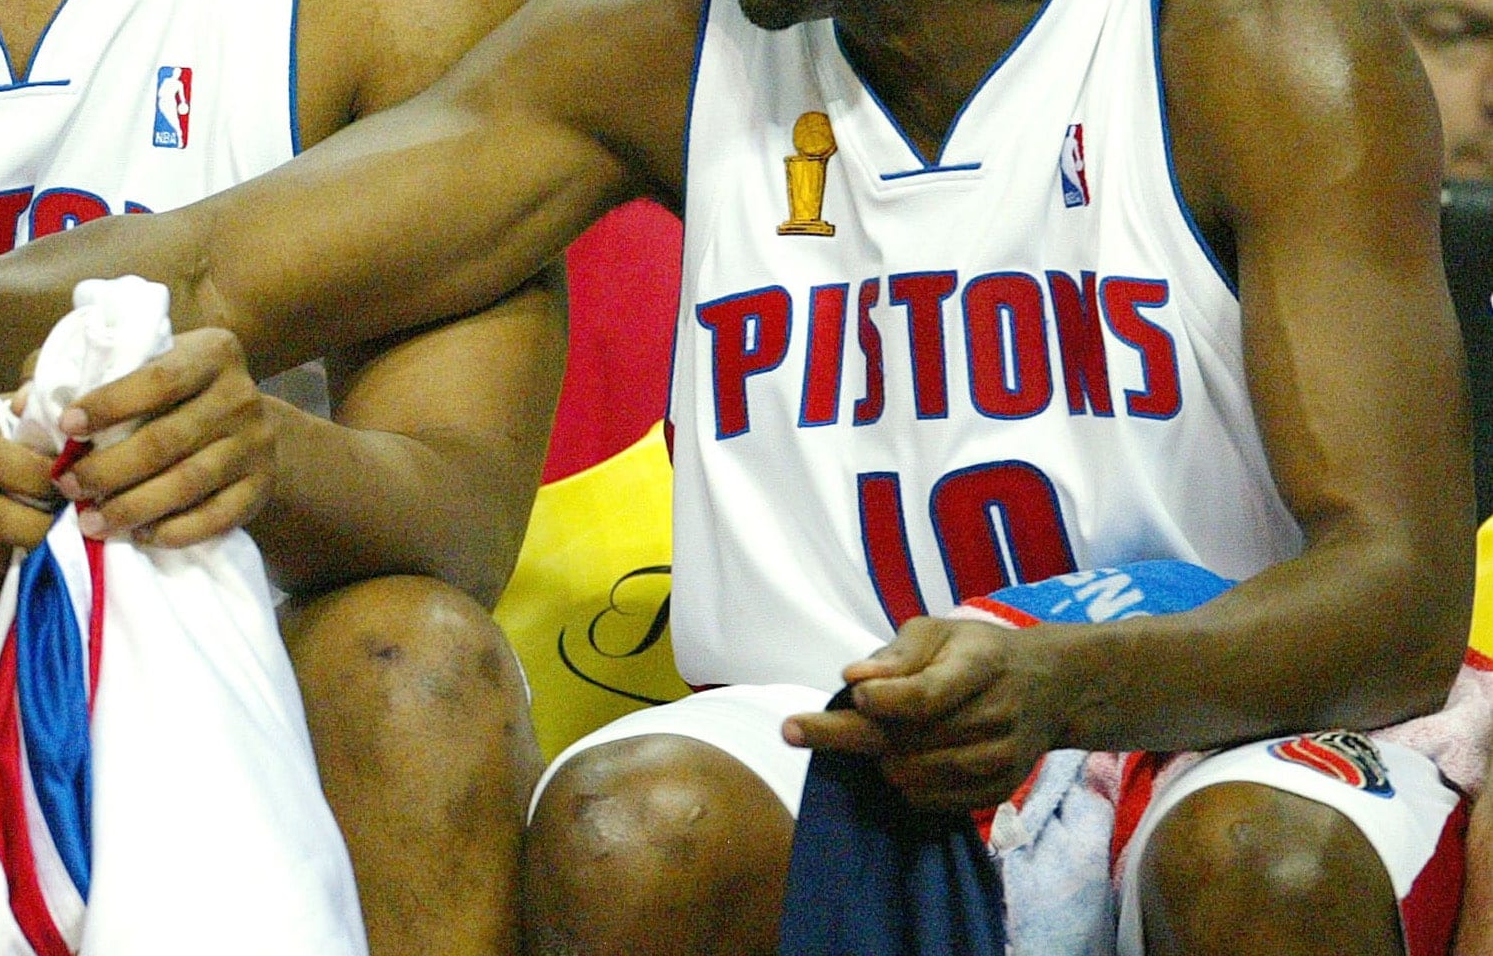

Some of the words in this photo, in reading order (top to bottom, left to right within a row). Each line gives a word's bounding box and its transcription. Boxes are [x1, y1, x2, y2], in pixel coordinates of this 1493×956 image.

[155, 131, 177, 144] NBA
[696, 270, 1183, 440] PISTONS
[857, 459, 1077, 634] 10
